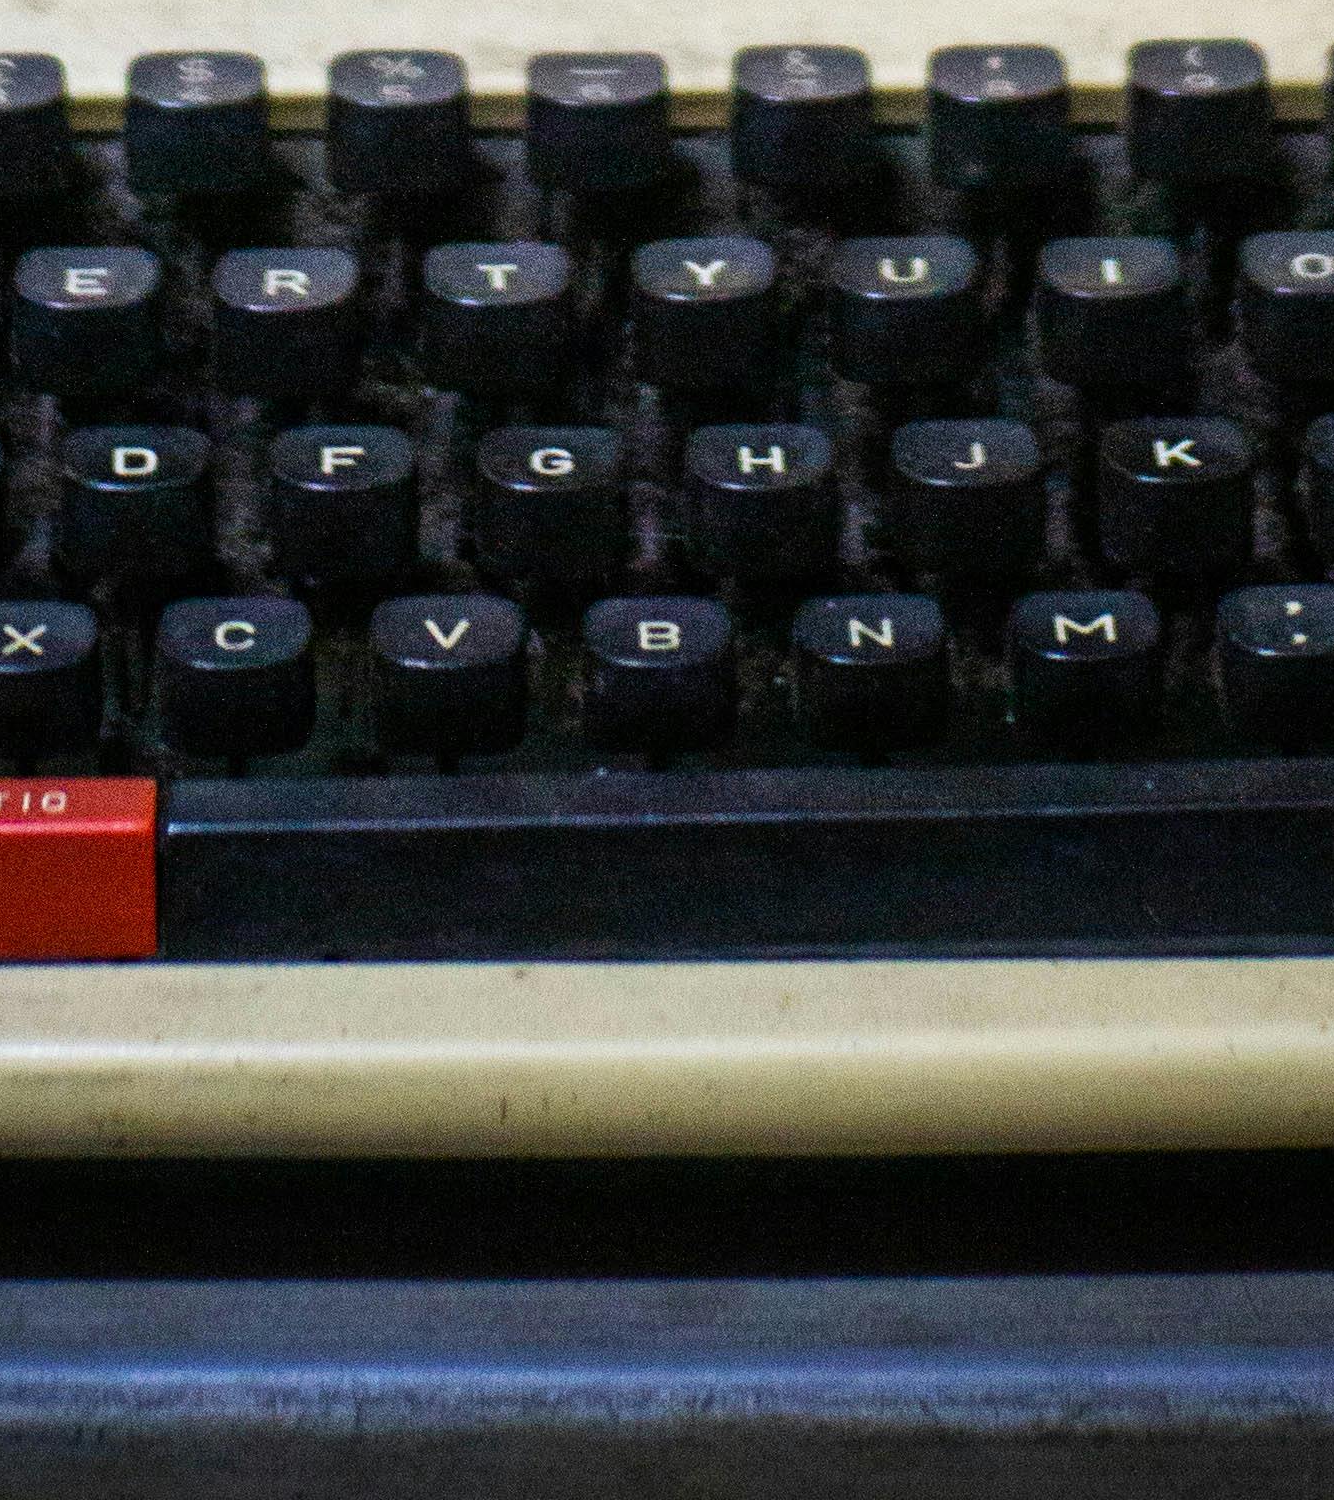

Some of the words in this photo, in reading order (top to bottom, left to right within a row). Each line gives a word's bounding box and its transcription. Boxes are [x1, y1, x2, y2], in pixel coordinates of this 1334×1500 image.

[178, 58, 214, 82] $
[369, 56, 424, 80] %
[66, 268, 108, 296] E
[265, 269, 309, 296] R
[477, 263, 518, 290] T
[682, 260, 728, 288] Y
[880, 257, 926, 283] U
[1099, 258, 1121, 284] I
[112, 447, 158, 476] D
[321, 446, 365, 476] F
[529, 447, 575, 476] G
[738, 445, 786, 475] H
[954, 441, 985, 470] J
[1153, 438, 1202, 467] K
[2, 624, 48, 656] X
[214, 621, 256, 651] C
[424, 620, 470, 650] V
[637, 621, 681, 651] B
[849, 617, 895, 647] N
[1052, 613, 1117, 644] M
